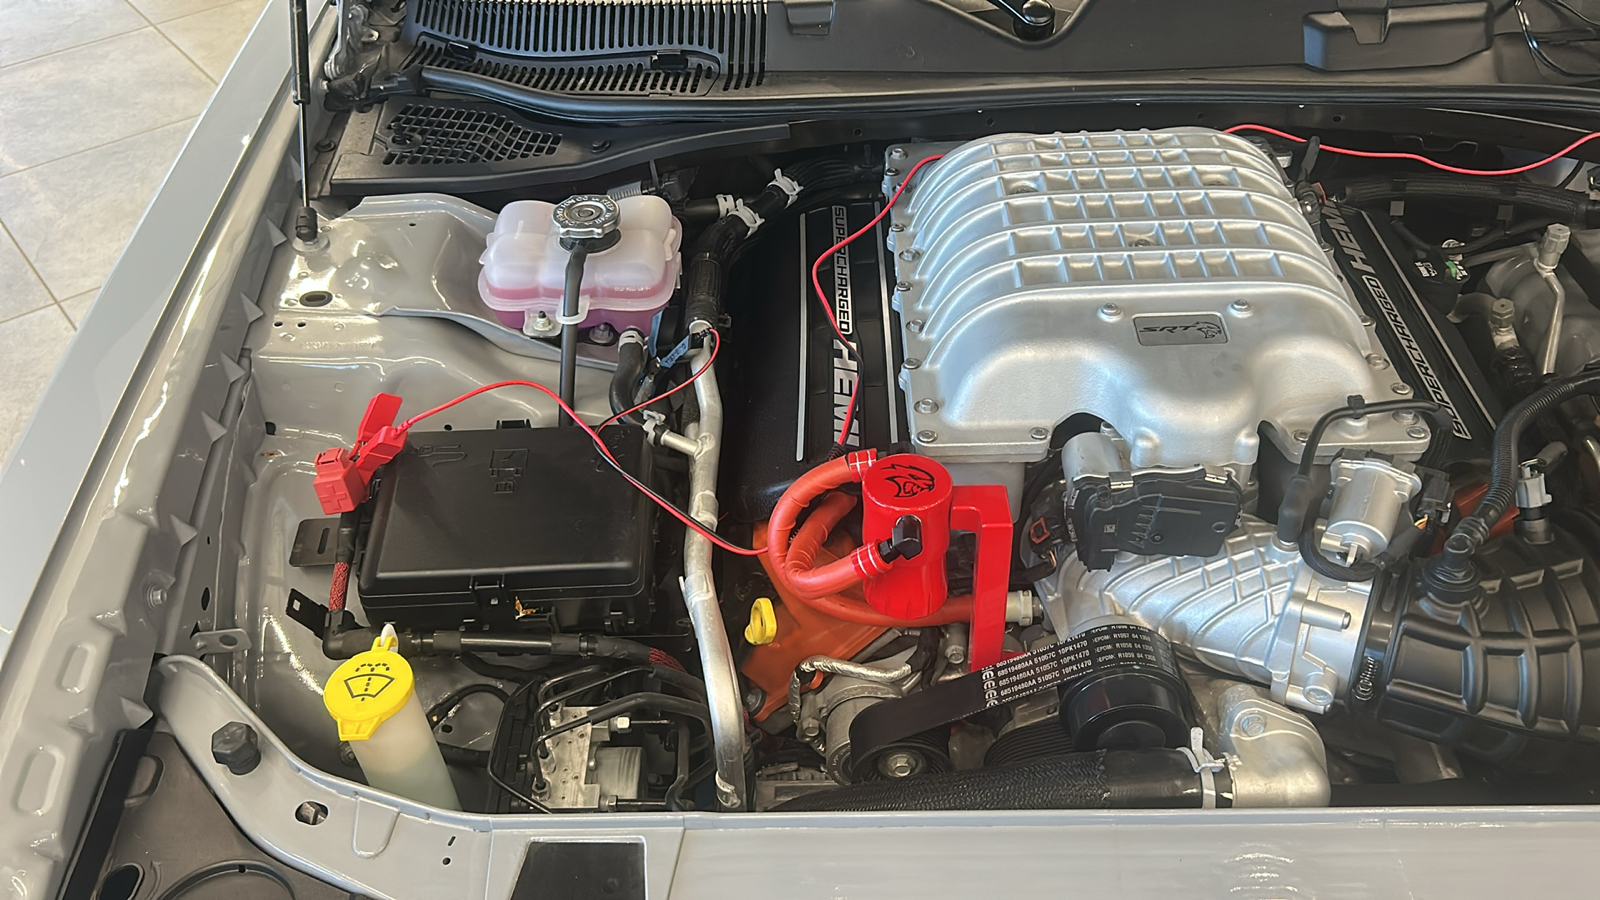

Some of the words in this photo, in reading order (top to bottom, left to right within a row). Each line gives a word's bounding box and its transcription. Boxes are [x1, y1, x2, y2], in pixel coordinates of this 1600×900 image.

[1138, 325, 1197, 334] SRT
[833, 339, 861, 447] HEMI
[1058, 640, 1088, 655] 10PK1470
[1035, 660, 1058, 674] 51057C
[1060, 649, 1090, 665] 10PK1470
[1037, 671, 1060, 684] 51057C
[1062, 659, 1092, 675] 10PK1470
